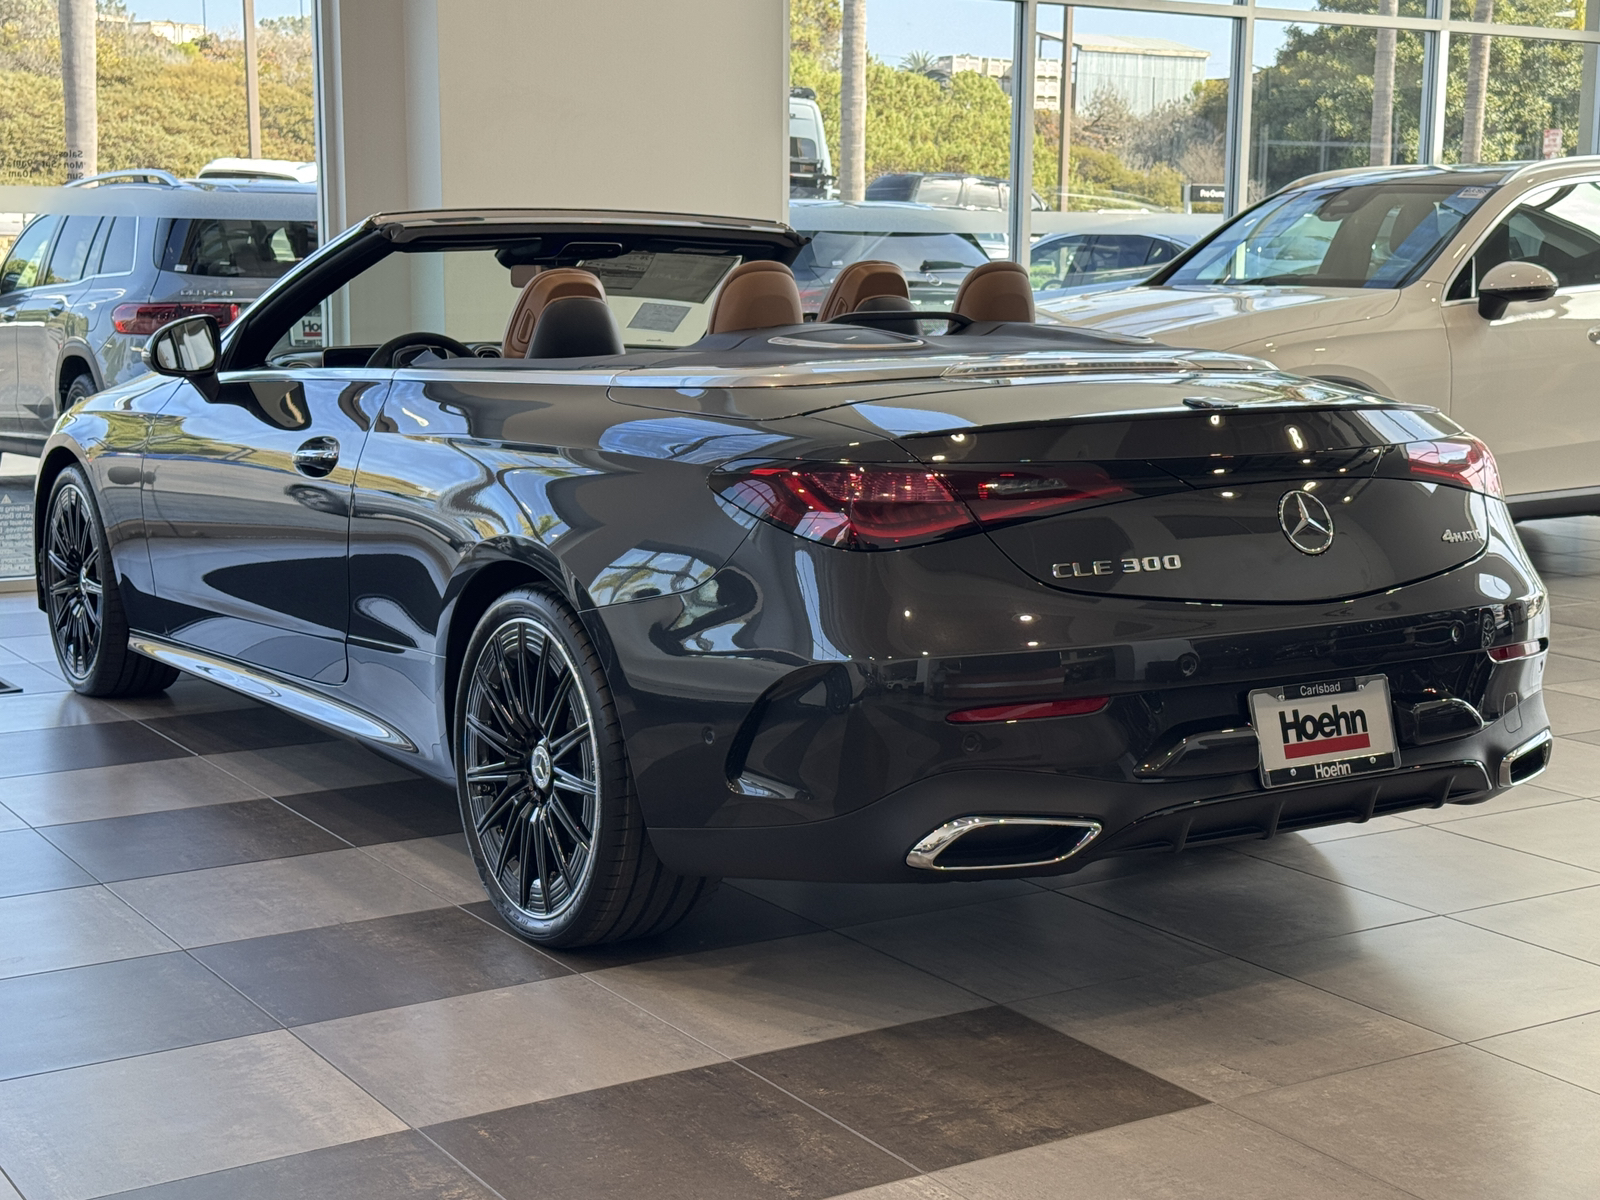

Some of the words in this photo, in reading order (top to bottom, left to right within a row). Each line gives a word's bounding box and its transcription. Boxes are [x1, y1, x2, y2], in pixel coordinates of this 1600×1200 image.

[1052, 560, 1114, 579] CLE
[1120, 554, 1182, 573] 300
[1300, 681, 1341, 697] Carlsbad
[1278, 704, 1368, 744] Hoehn
[1314, 761, 1352, 779] Hoehn
